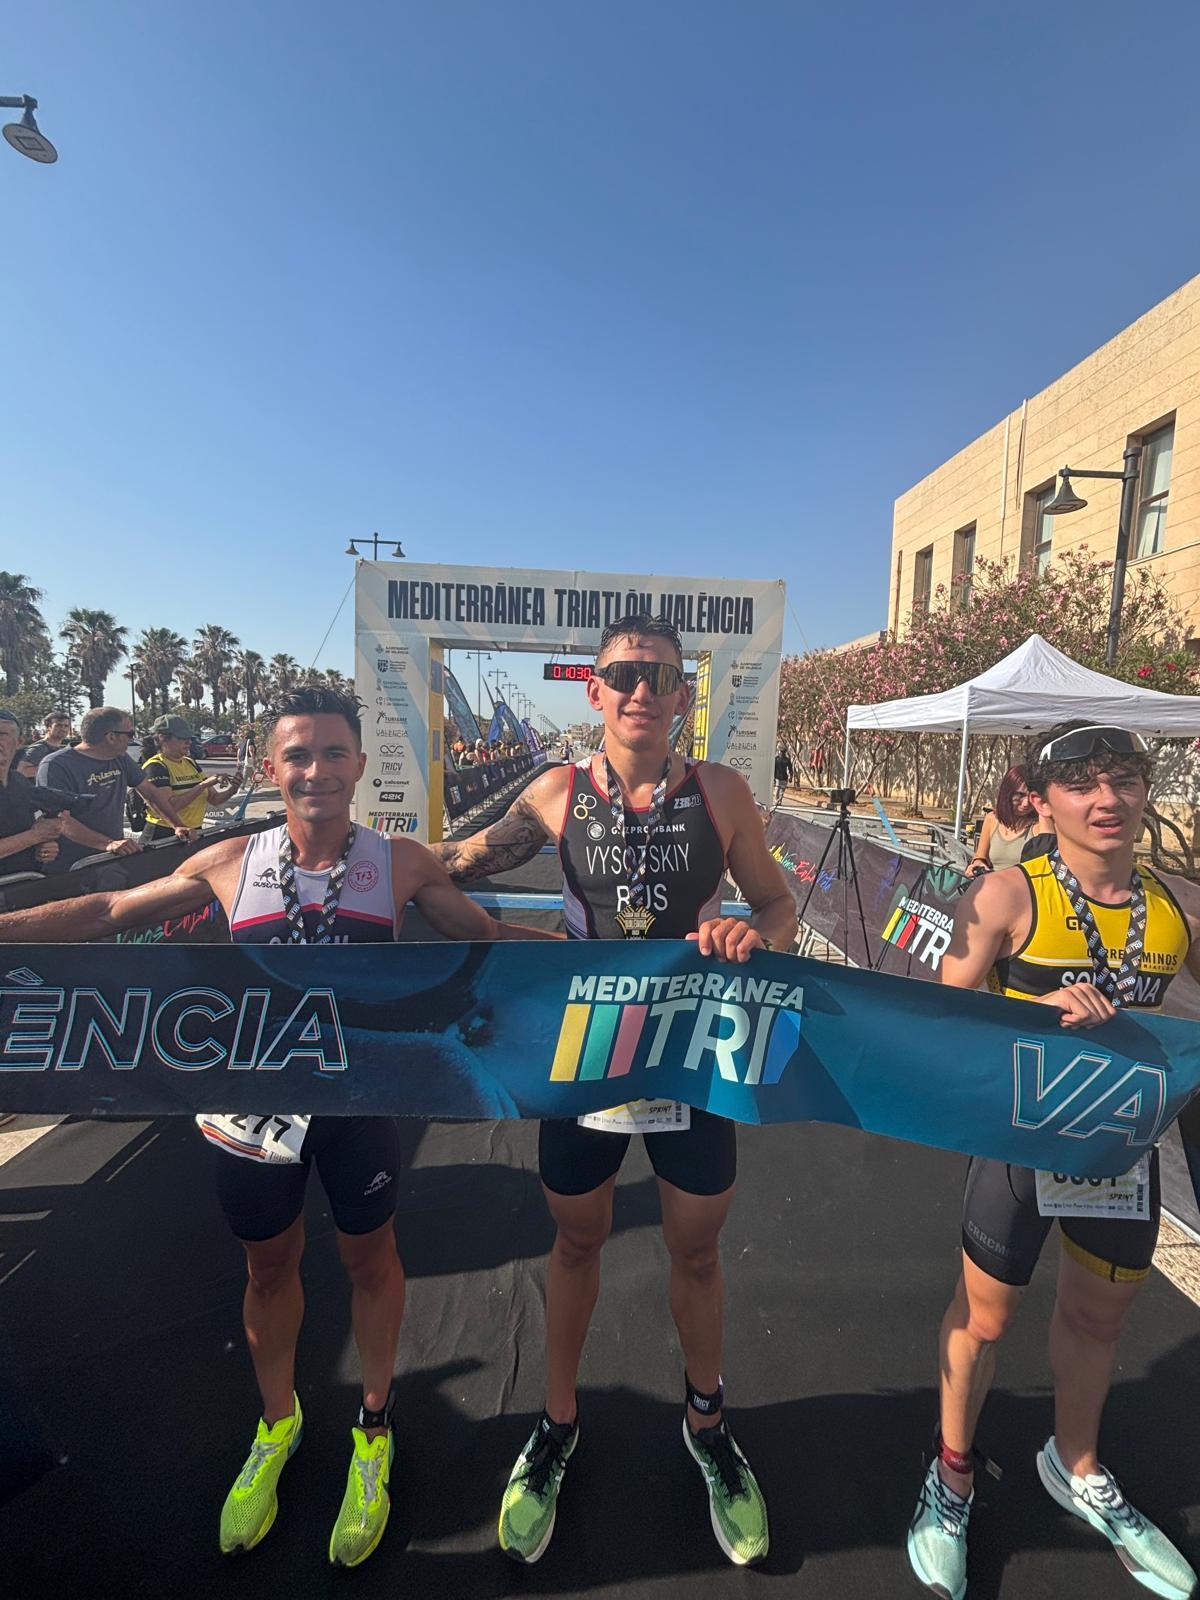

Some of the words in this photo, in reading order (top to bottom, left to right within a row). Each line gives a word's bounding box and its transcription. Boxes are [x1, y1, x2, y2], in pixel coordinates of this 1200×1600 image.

[384, 817, 412, 833] TRI
[611, 823, 686, 835] GZPROBANK
[567, 972, 804, 1010] MEDITERRANEA
[645, 998, 775, 1085] TRI
